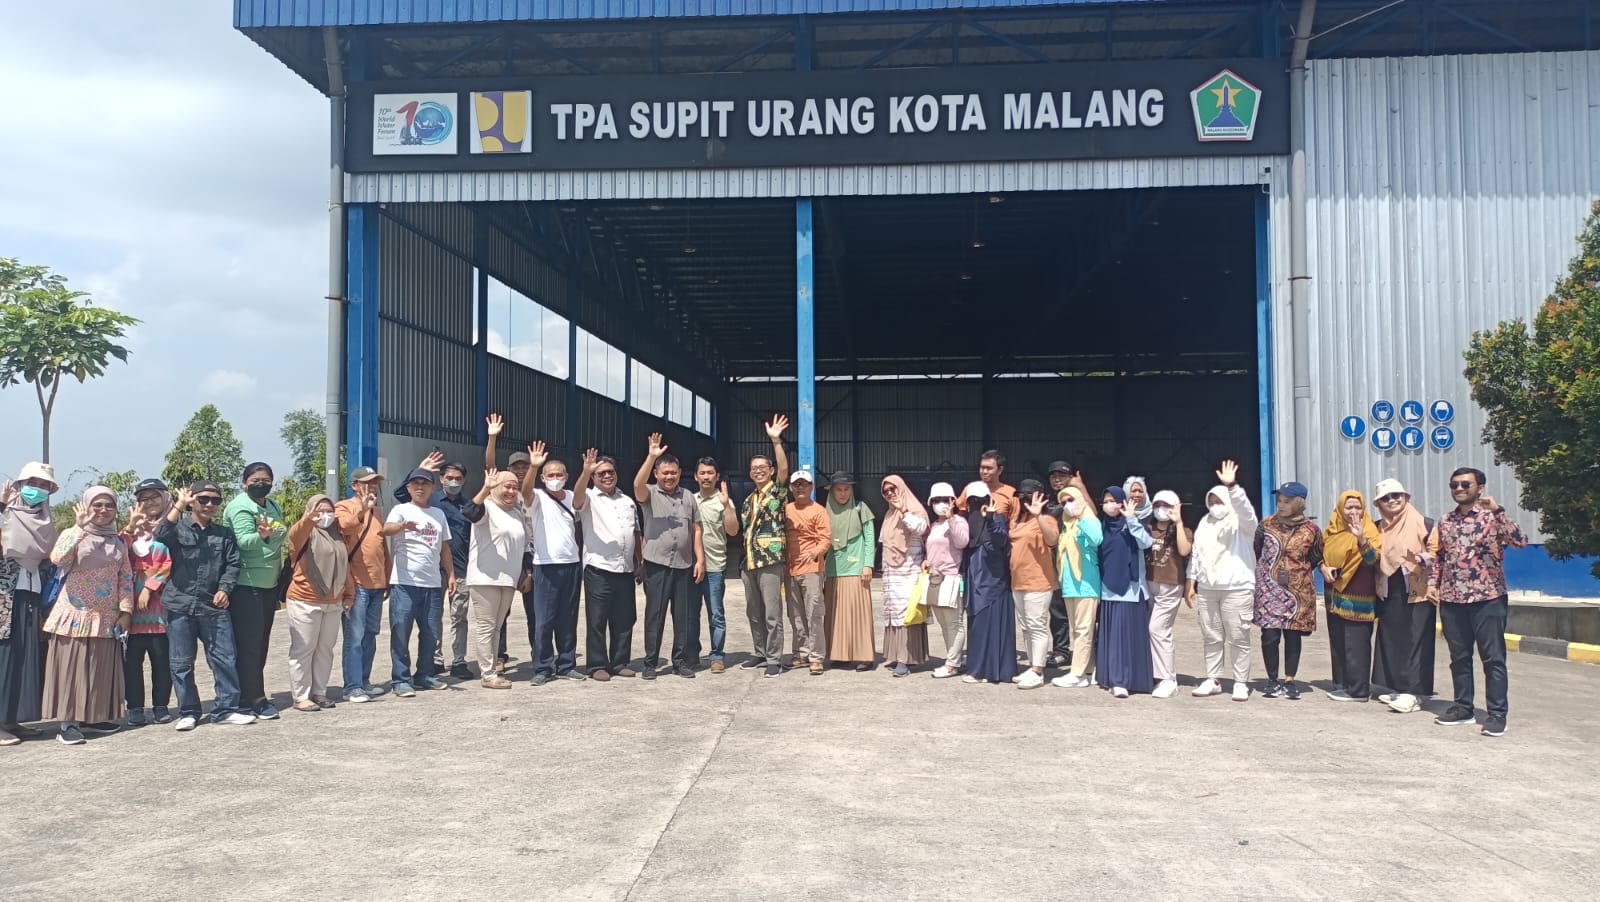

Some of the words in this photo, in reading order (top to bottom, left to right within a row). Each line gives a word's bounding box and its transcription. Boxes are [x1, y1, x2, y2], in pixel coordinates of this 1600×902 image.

[550, 103, 619, 140] TPA
[628, 100, 735, 139] SUPIT
[748, 97, 875, 137] URANG
[889, 94, 987, 133] KOTA
[1003, 88, 1164, 130] MALANG
